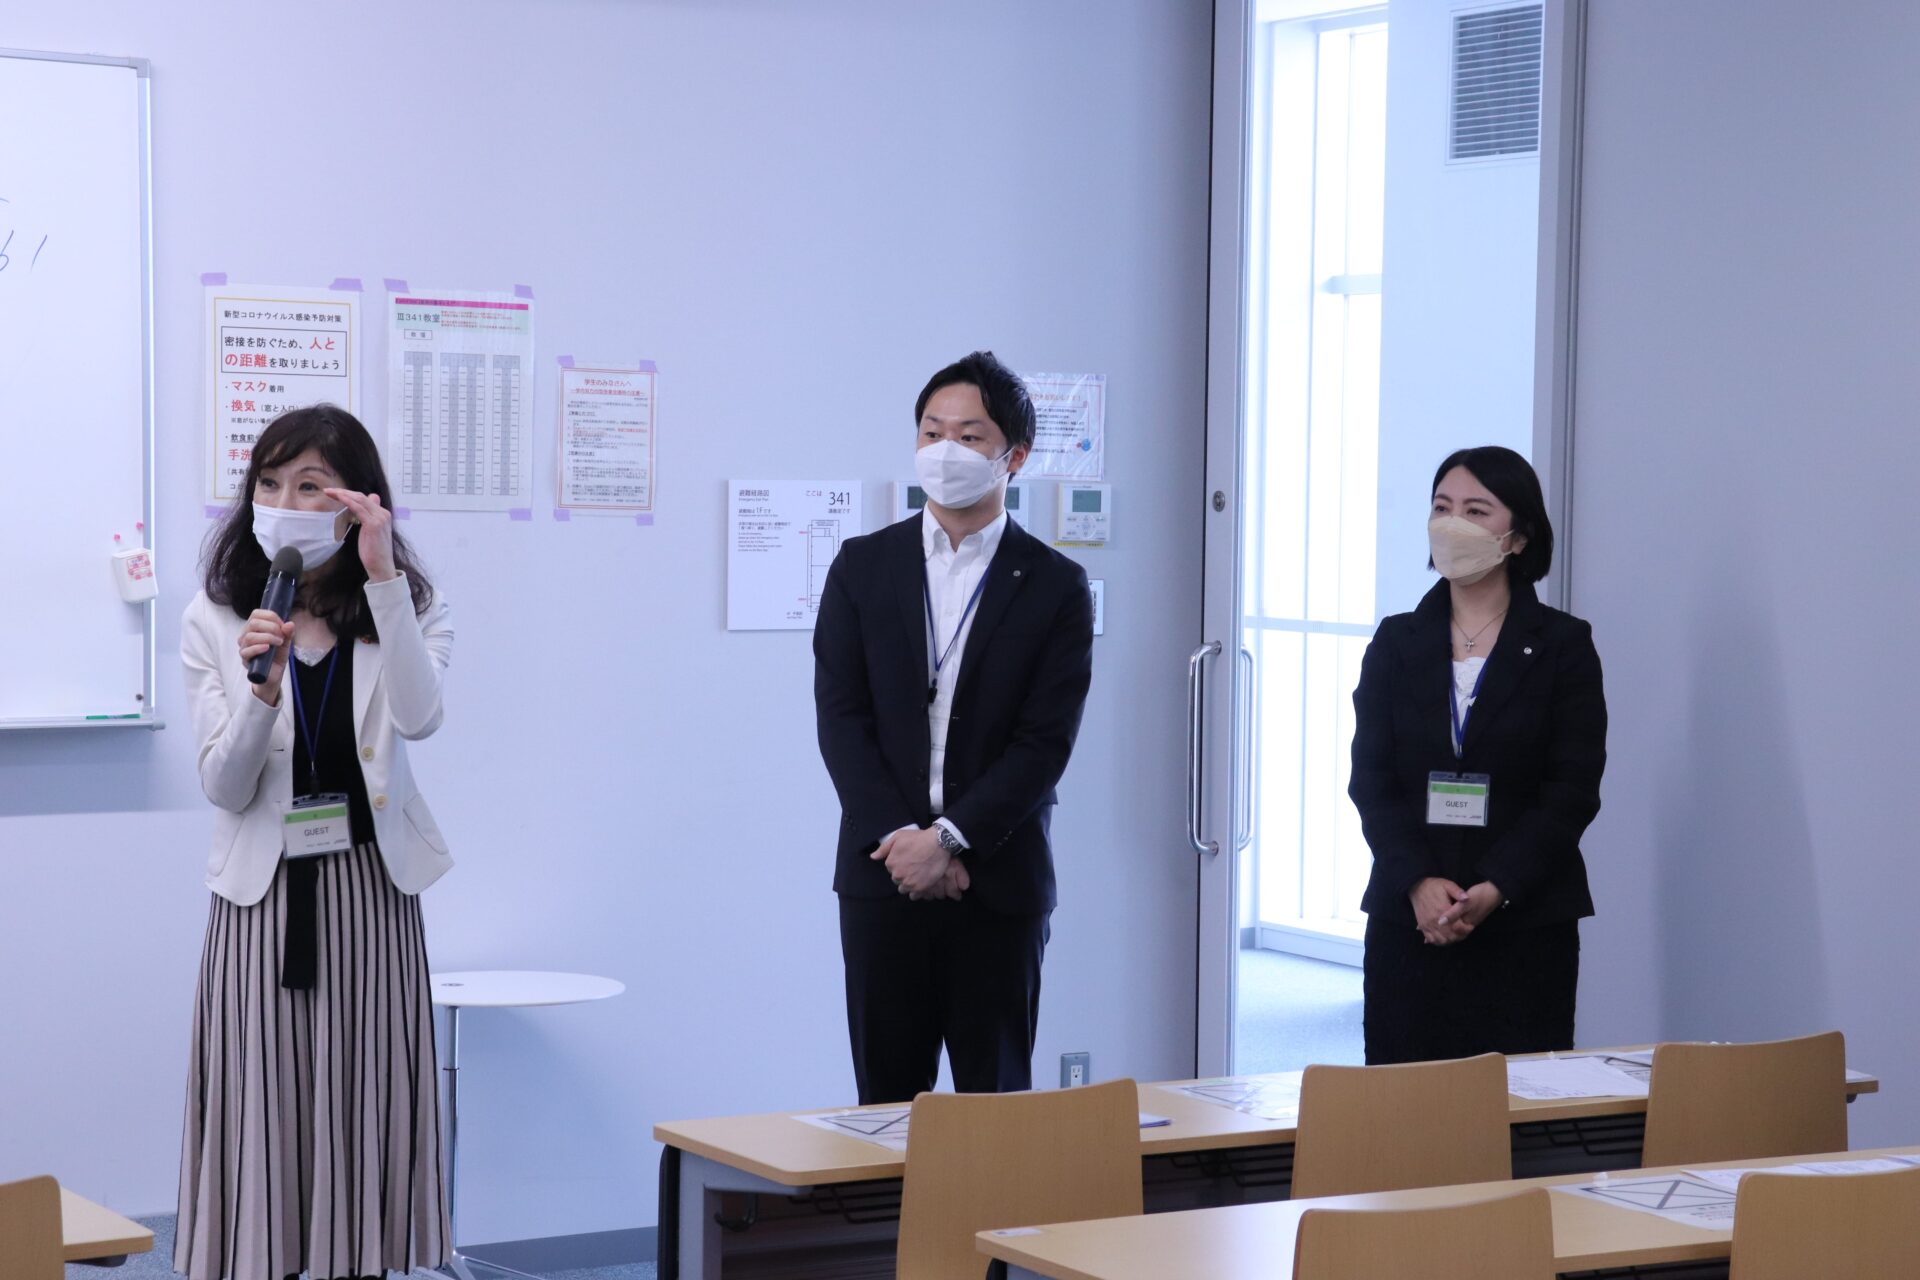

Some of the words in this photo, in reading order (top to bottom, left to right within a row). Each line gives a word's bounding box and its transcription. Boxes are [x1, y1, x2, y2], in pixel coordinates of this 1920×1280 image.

[224, 310, 342, 323] 新型コロナウイルス感染予防対策
[224, 336, 335, 350] 密接を防ぐため、人と
[225, 353, 340, 370] の距離を取りましょう
[828, 491, 850, 506] 341
[304, 826, 329, 837] GUEST
